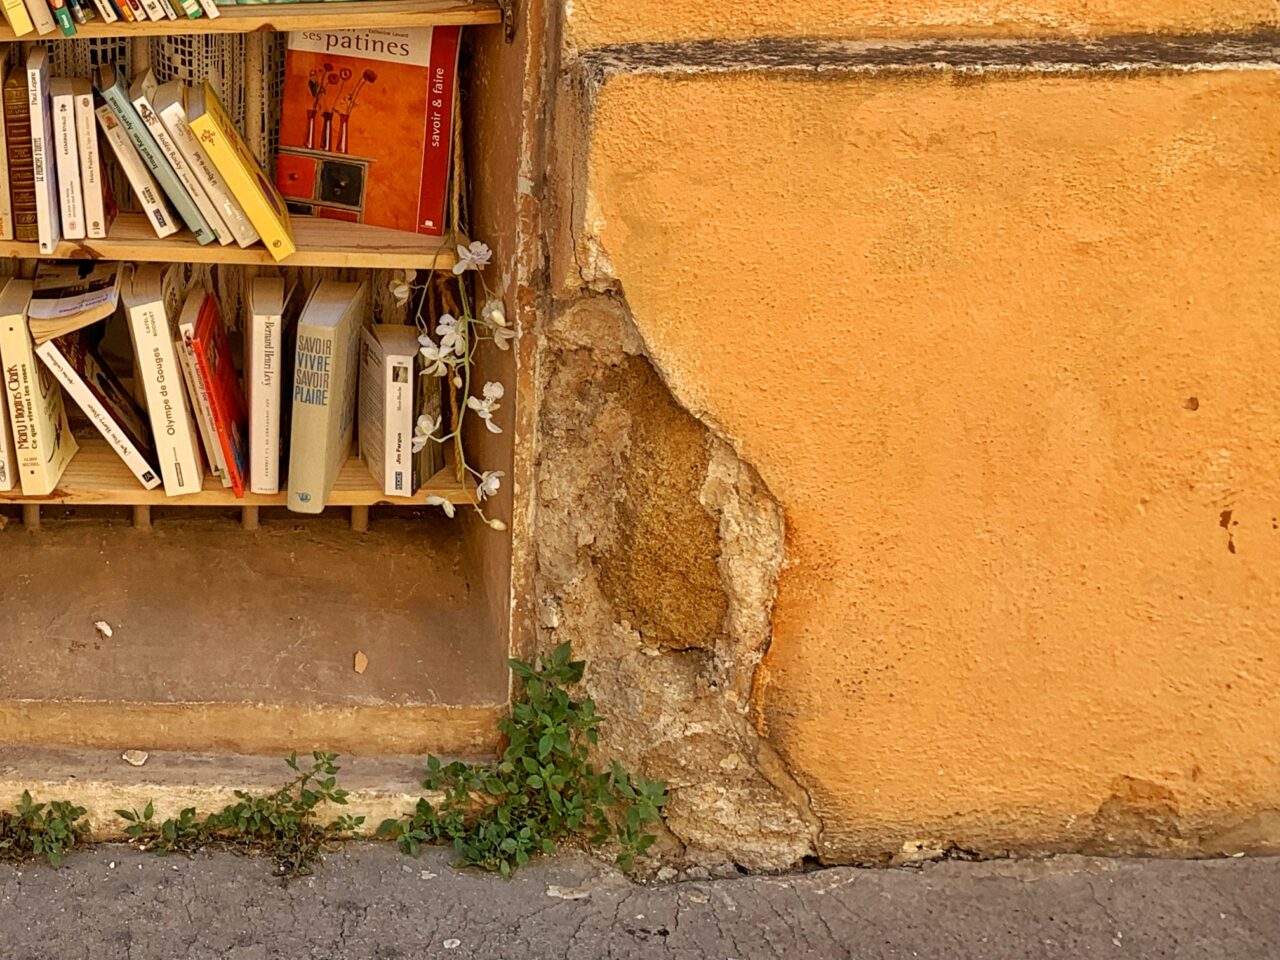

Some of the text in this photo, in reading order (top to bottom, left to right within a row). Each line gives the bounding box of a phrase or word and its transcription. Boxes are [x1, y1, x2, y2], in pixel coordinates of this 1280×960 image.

[302, 31, 410, 57] ses patines
[430, 67, 445, 148] savoir & faire
[108, 96, 158, 170] Irmgard Keun Après minuit
[156, 132, 171, 152] Rodéo
[168, 150, 183, 170] Rocky
[34, 156, 43, 175] PRINCIPE
[260, 321, 275, 386] Bernard Henri Lévy
[298, 334, 332, 356] SAVOIR
[20, 363, 28, 383] roses
[297, 351, 331, 373] VIVRE
[295, 368, 330, 389] SAVOIR
[152, 346, 176, 436] Olympe de Gouges
[294, 385, 328, 406] PLAIRE
[5, 363, 29, 449] Mary Higgins Clark
[24, 397, 33, 422] vivent
[86, 403, 100, 418] Potter
[29, 424, 37, 437] que
[98, 417, 112, 433] Harry
[30, 438, 37, 449] Ce
